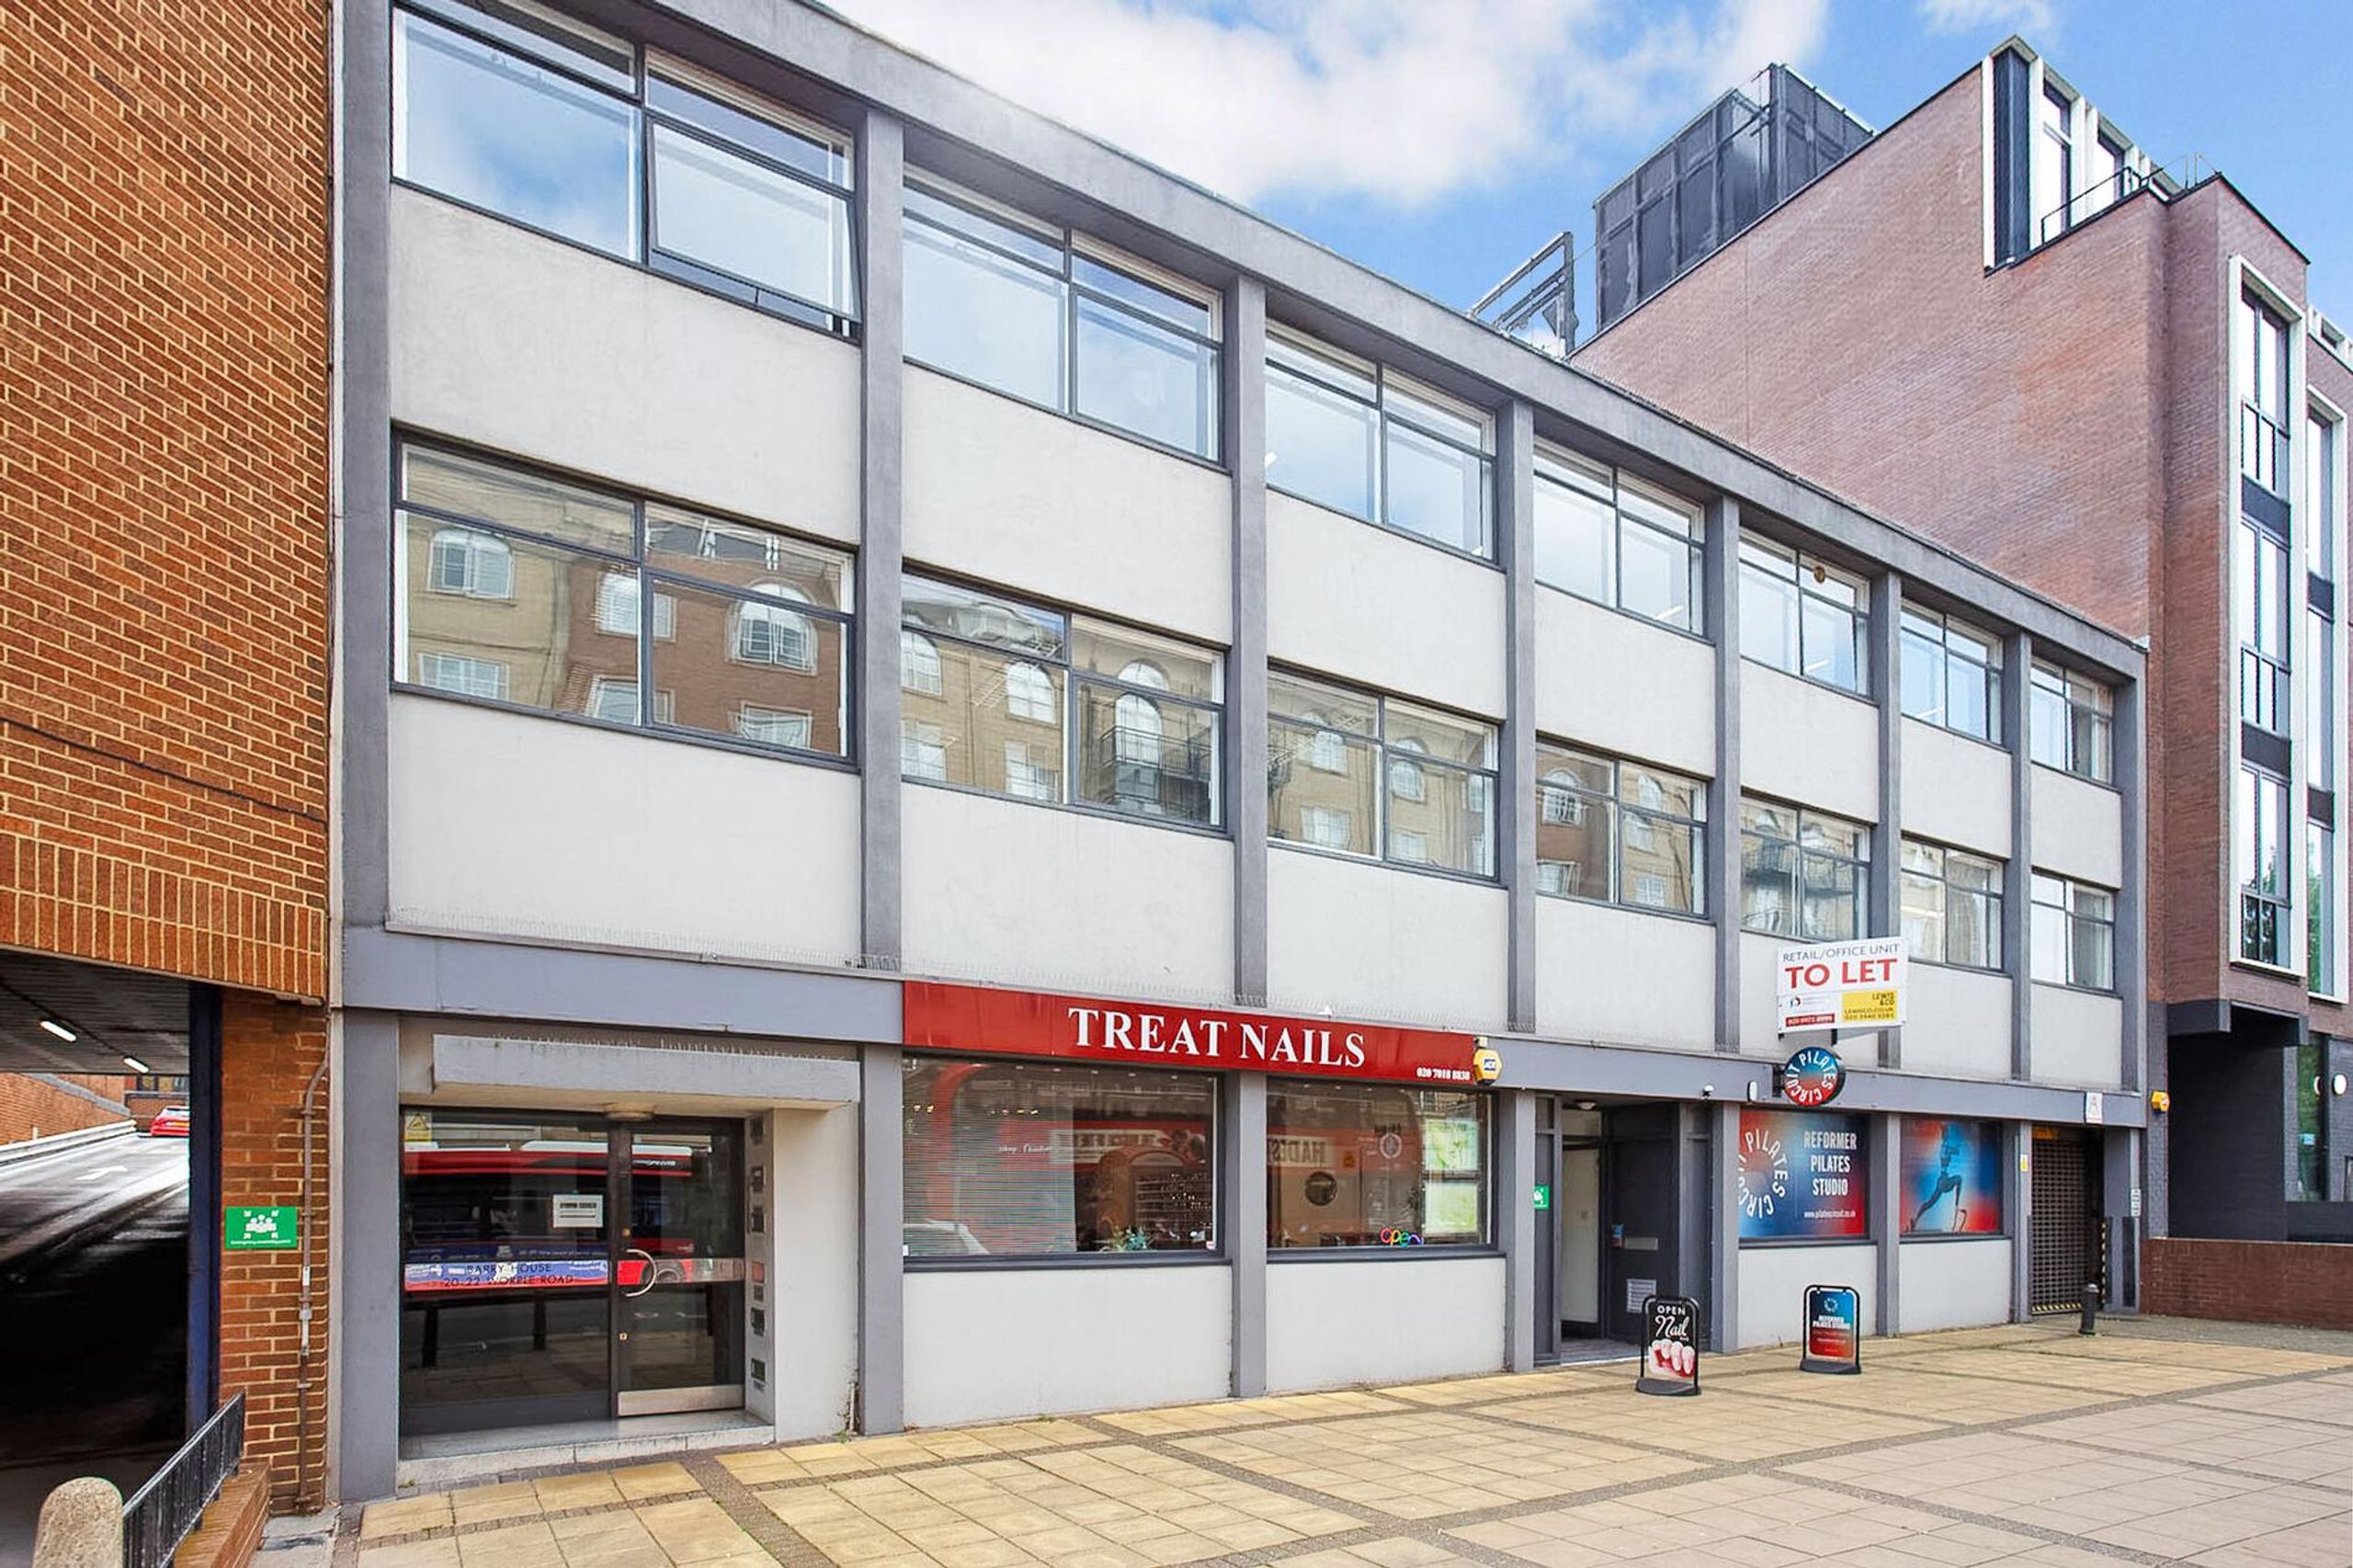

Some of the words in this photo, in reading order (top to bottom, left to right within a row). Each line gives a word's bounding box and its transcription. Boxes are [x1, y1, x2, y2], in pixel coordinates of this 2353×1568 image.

[1782, 946, 1868, 961] RETAIL/OFFICE
[1869, 944, 1899, 955] UNIT
[1785, 963, 1830, 988] TO
[1842, 958, 1897, 983] LET
[1068, 1007, 1228, 1056] TREAT
[1240, 1023, 1365, 1068] NAILS
[1416, 1067, 1432, 1078] 020
[1799, 1051, 1837, 1090] PILATES
[1786, 1063, 1823, 1103] CIRCUIT
[1803, 1131, 1857, 1150] REFORMER
[1745, 1129, 1789, 1198] PILATES
[1811, 1154, 1850, 1173] PILATES
[1813, 1178, 1848, 1196] STUDIO
[466, 1265, 504, 1277] BARRY
[511, 1263, 551, 1273] HOUSE
[488, 1276, 535, 1286] WORPLE
[541, 1274, 574, 1285] ROAD
[1657, 1304, 1686, 1315] OPEN
[1654, 1314, 1689, 1338] Nail
